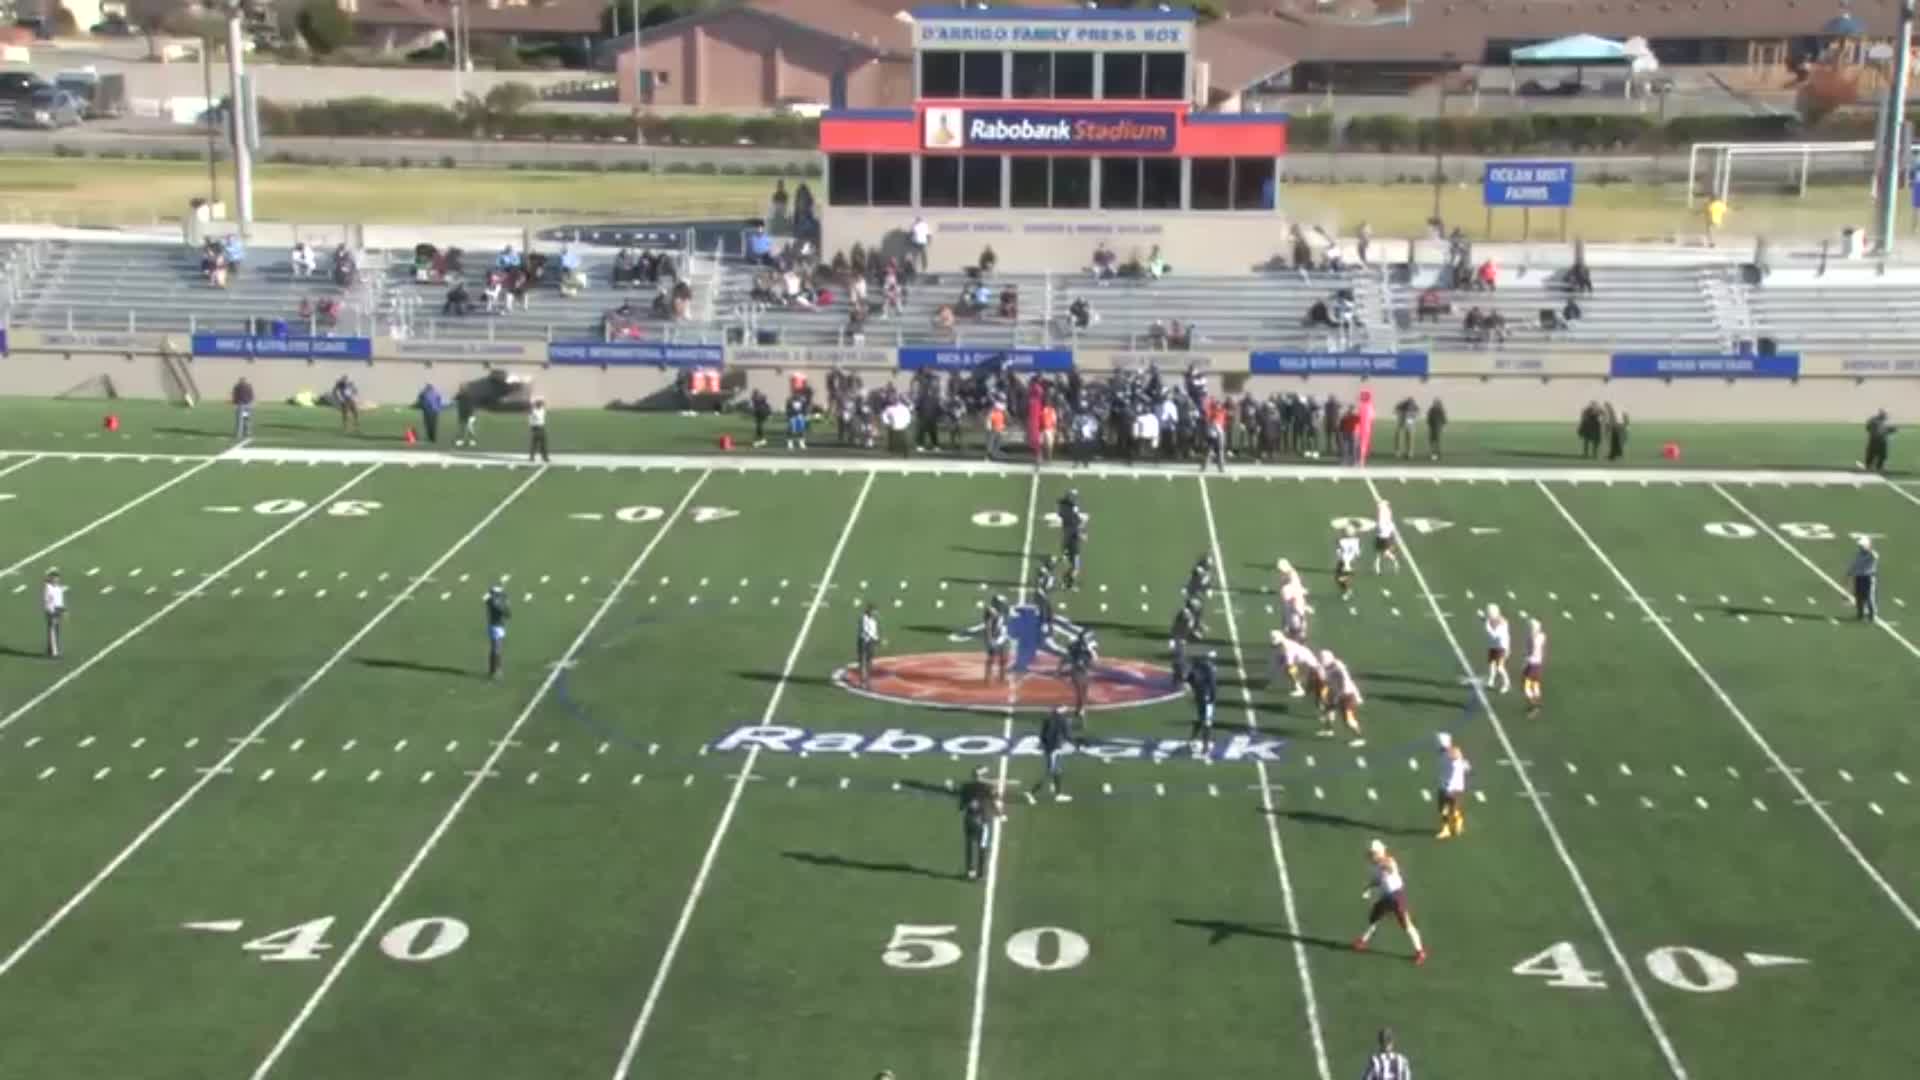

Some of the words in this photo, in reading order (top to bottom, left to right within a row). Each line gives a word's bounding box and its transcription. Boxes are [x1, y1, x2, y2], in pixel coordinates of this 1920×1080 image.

[1076, 27, 1137, 42] PRESS
[970, 118, 1070, 141] Rabobank
[1072, 119, 1168, 142] Stadium
[241, 915, 470, 963] 40
[881, 924, 1090, 971] 50
[1511, 941, 1738, 992] 40
